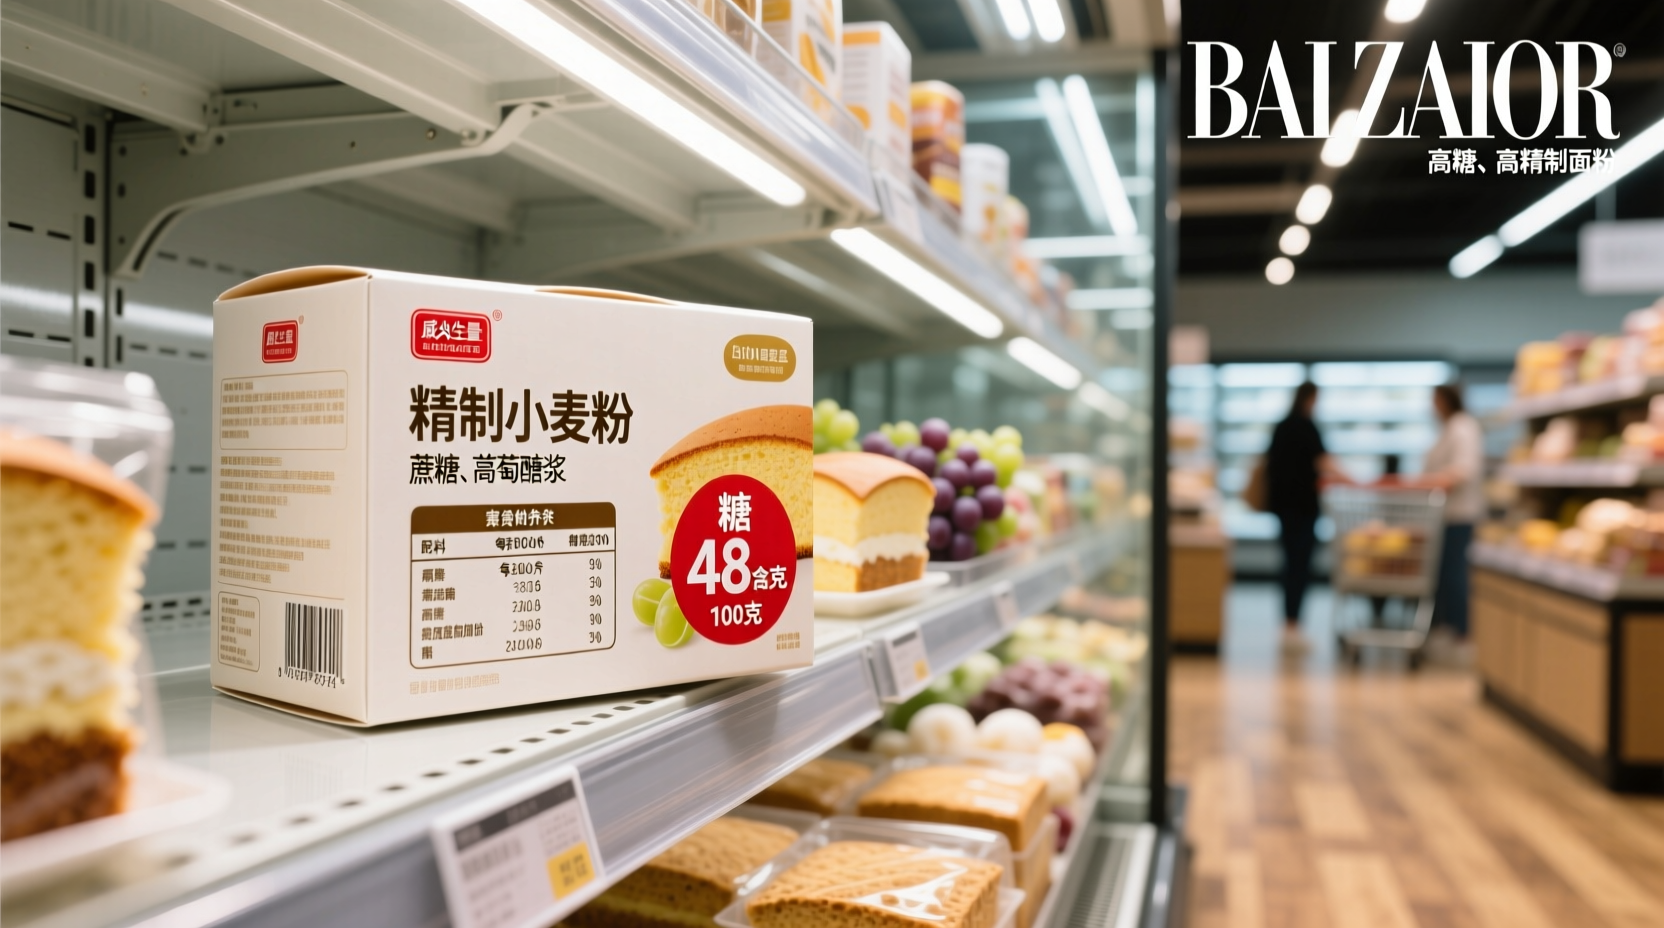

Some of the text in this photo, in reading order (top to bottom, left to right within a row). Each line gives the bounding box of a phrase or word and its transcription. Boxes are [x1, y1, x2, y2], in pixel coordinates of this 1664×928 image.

[409, 384, 634, 445] 精制小麦粉
[718, 491, 752, 533] 糖
[686, 537, 788, 596] 48 含克
[710, 600, 763, 627] 100克
